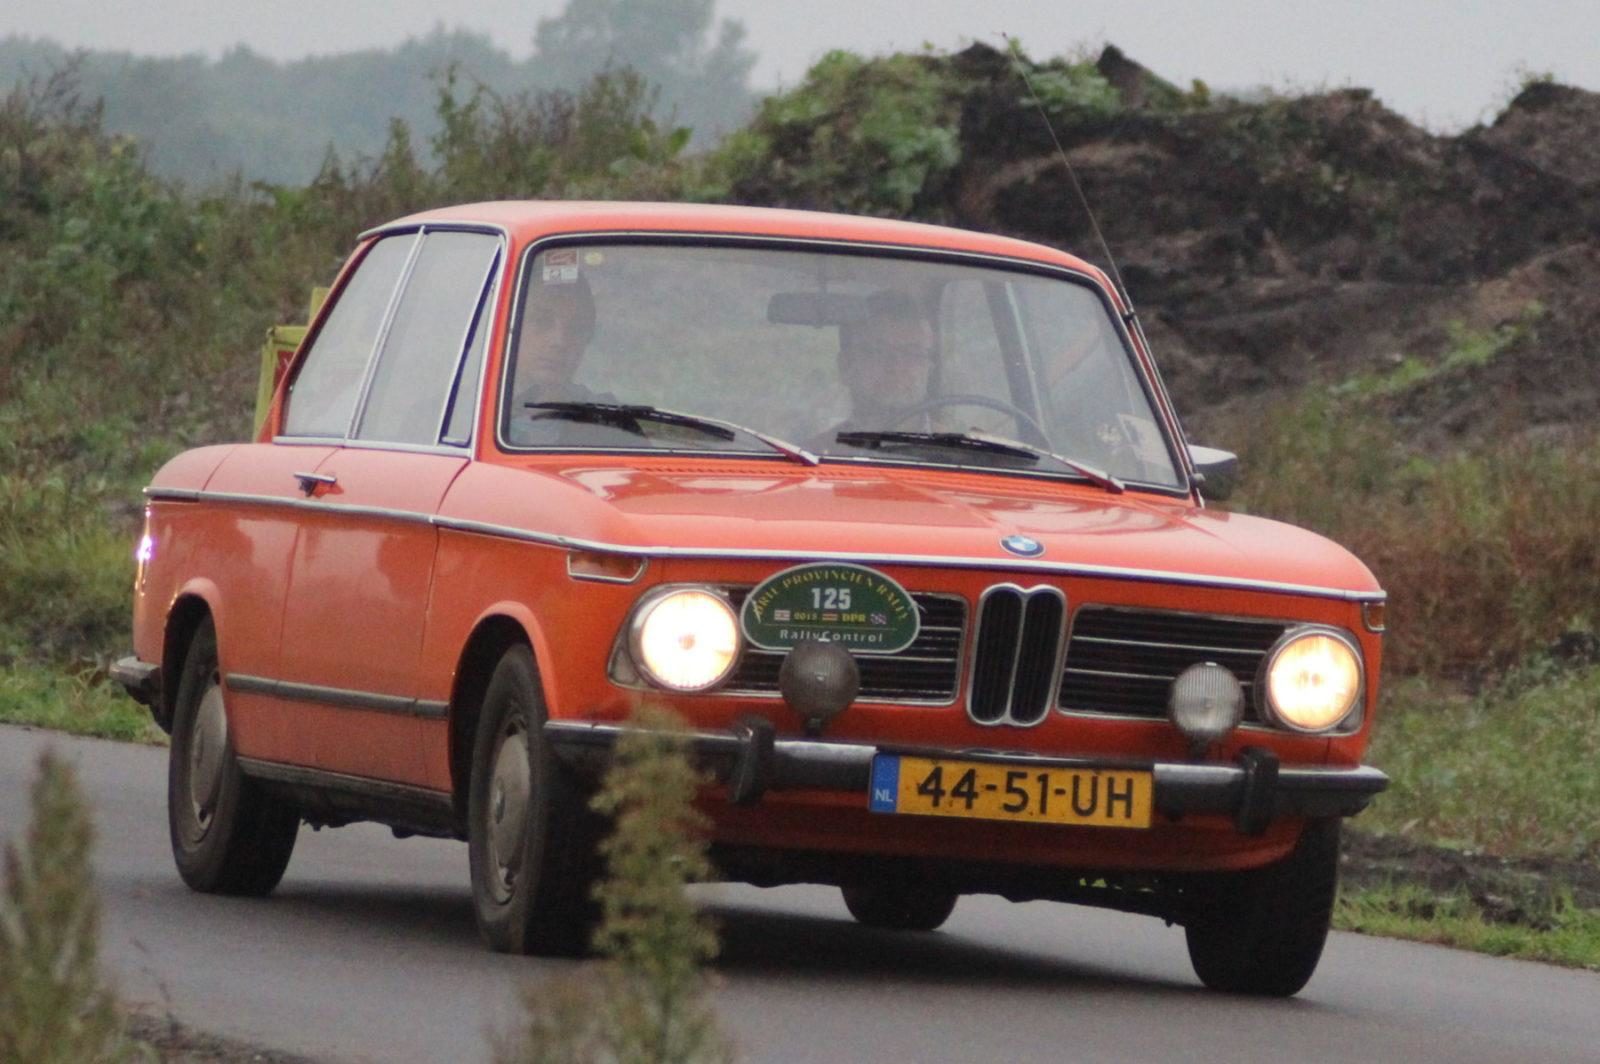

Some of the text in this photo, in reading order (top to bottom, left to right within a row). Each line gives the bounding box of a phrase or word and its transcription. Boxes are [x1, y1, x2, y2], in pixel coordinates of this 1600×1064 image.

[811, 588, 852, 610] 125
[779, 629, 884, 643] RallyControl
[875, 788, 894, 803] NL
[917, 766, 1134, 819] 44-51-UH
